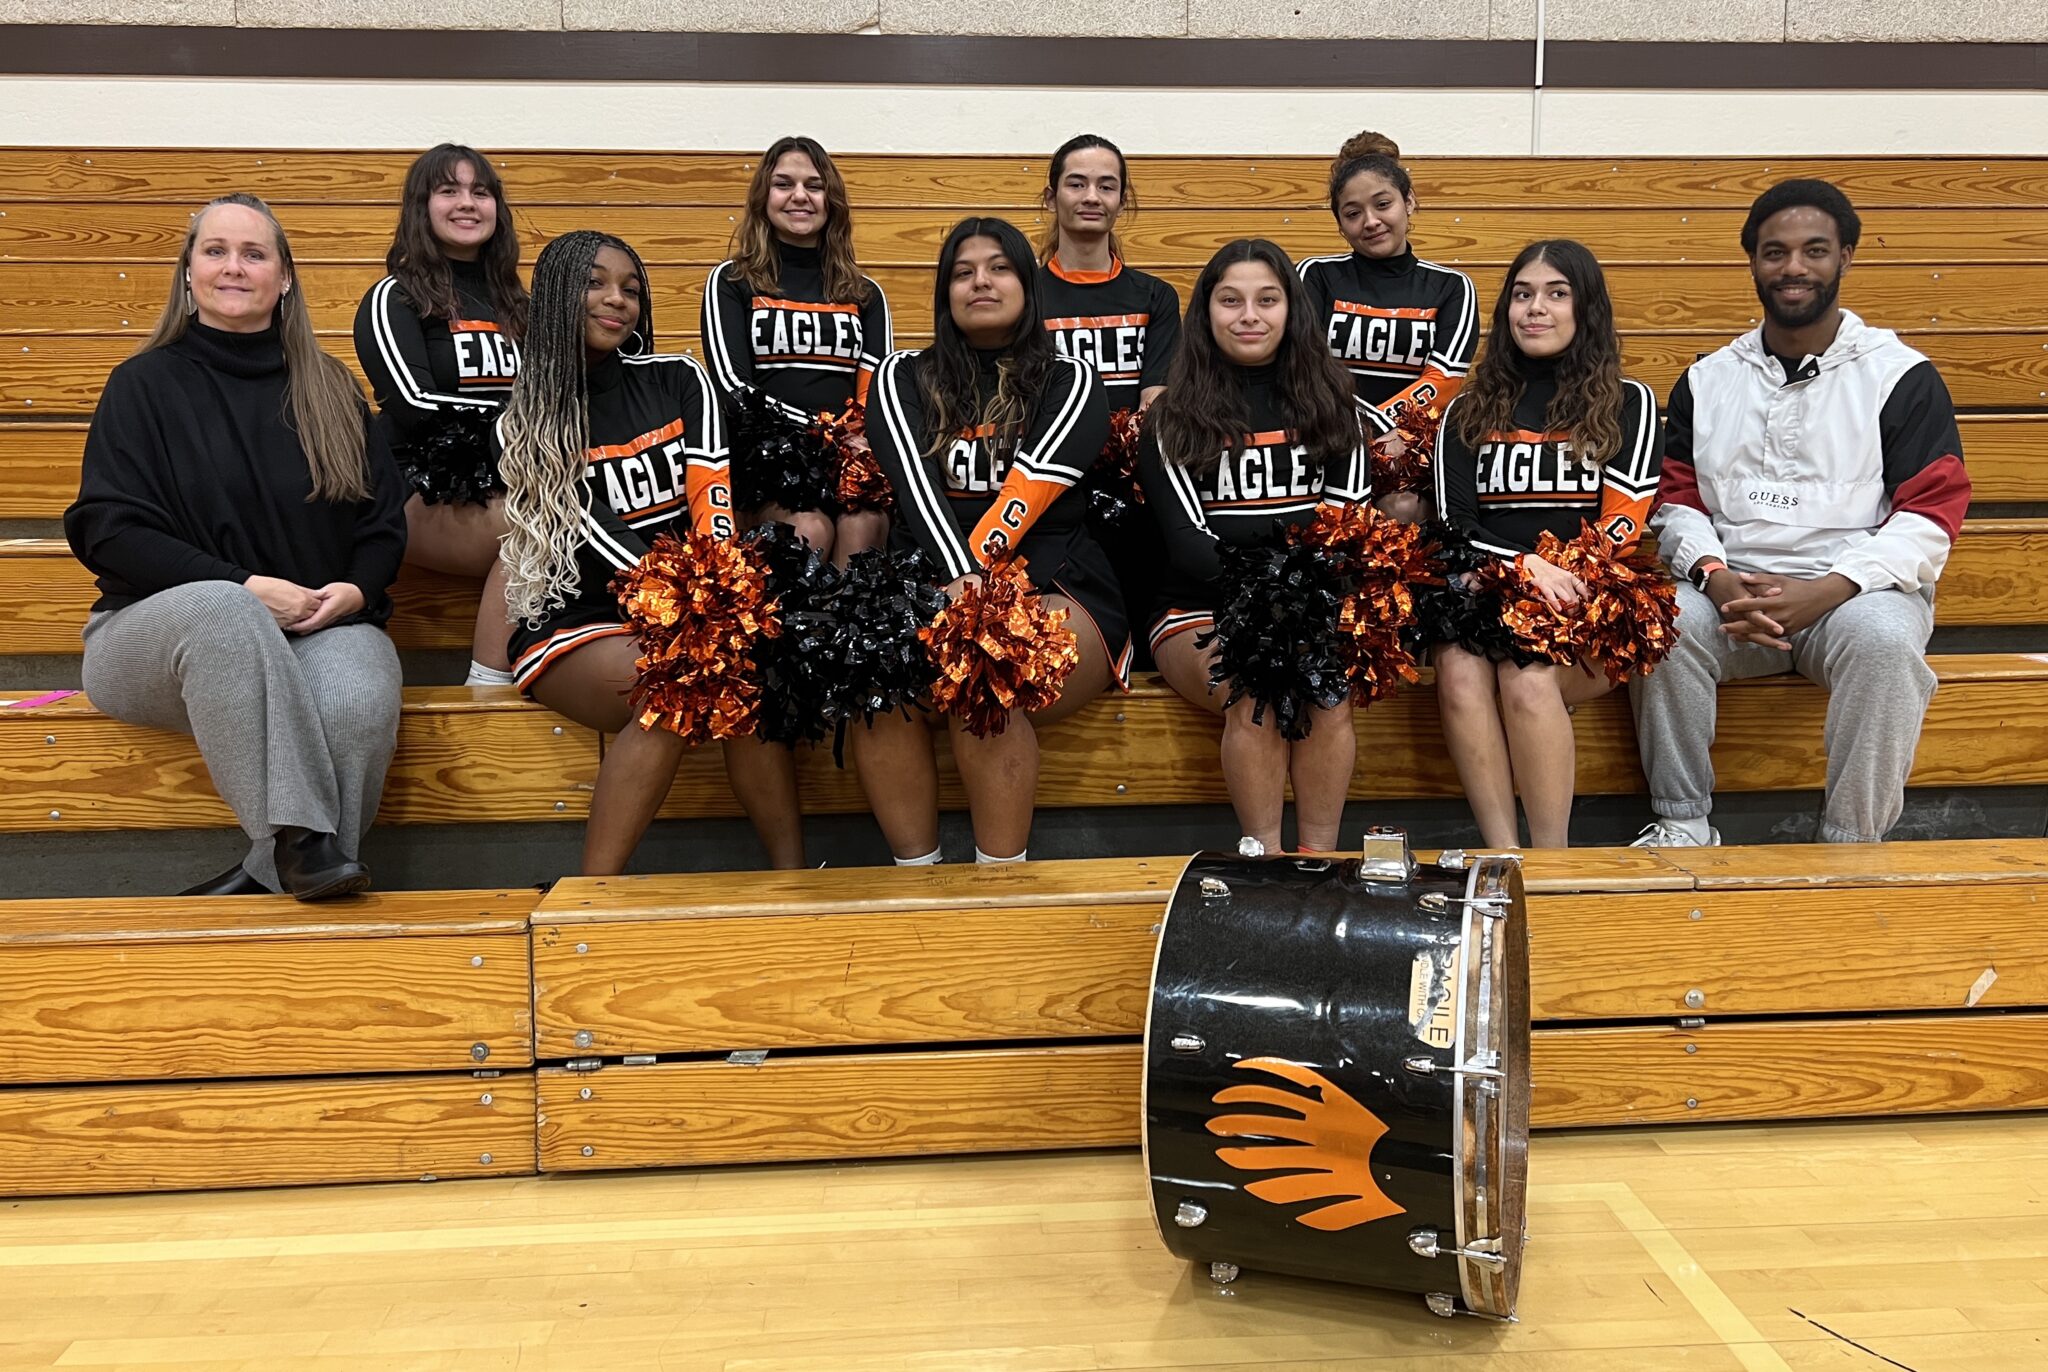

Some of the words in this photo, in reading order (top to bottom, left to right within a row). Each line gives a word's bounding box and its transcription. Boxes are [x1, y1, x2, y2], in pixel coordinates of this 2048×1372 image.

[751, 309, 863, 359] EAGLES
[584, 437, 687, 515] AGLE
[1476, 442, 1600, 493] EAGLES
[1748, 491, 1799, 506] GUESS
[1416, 982, 1428, 1006] WITH
